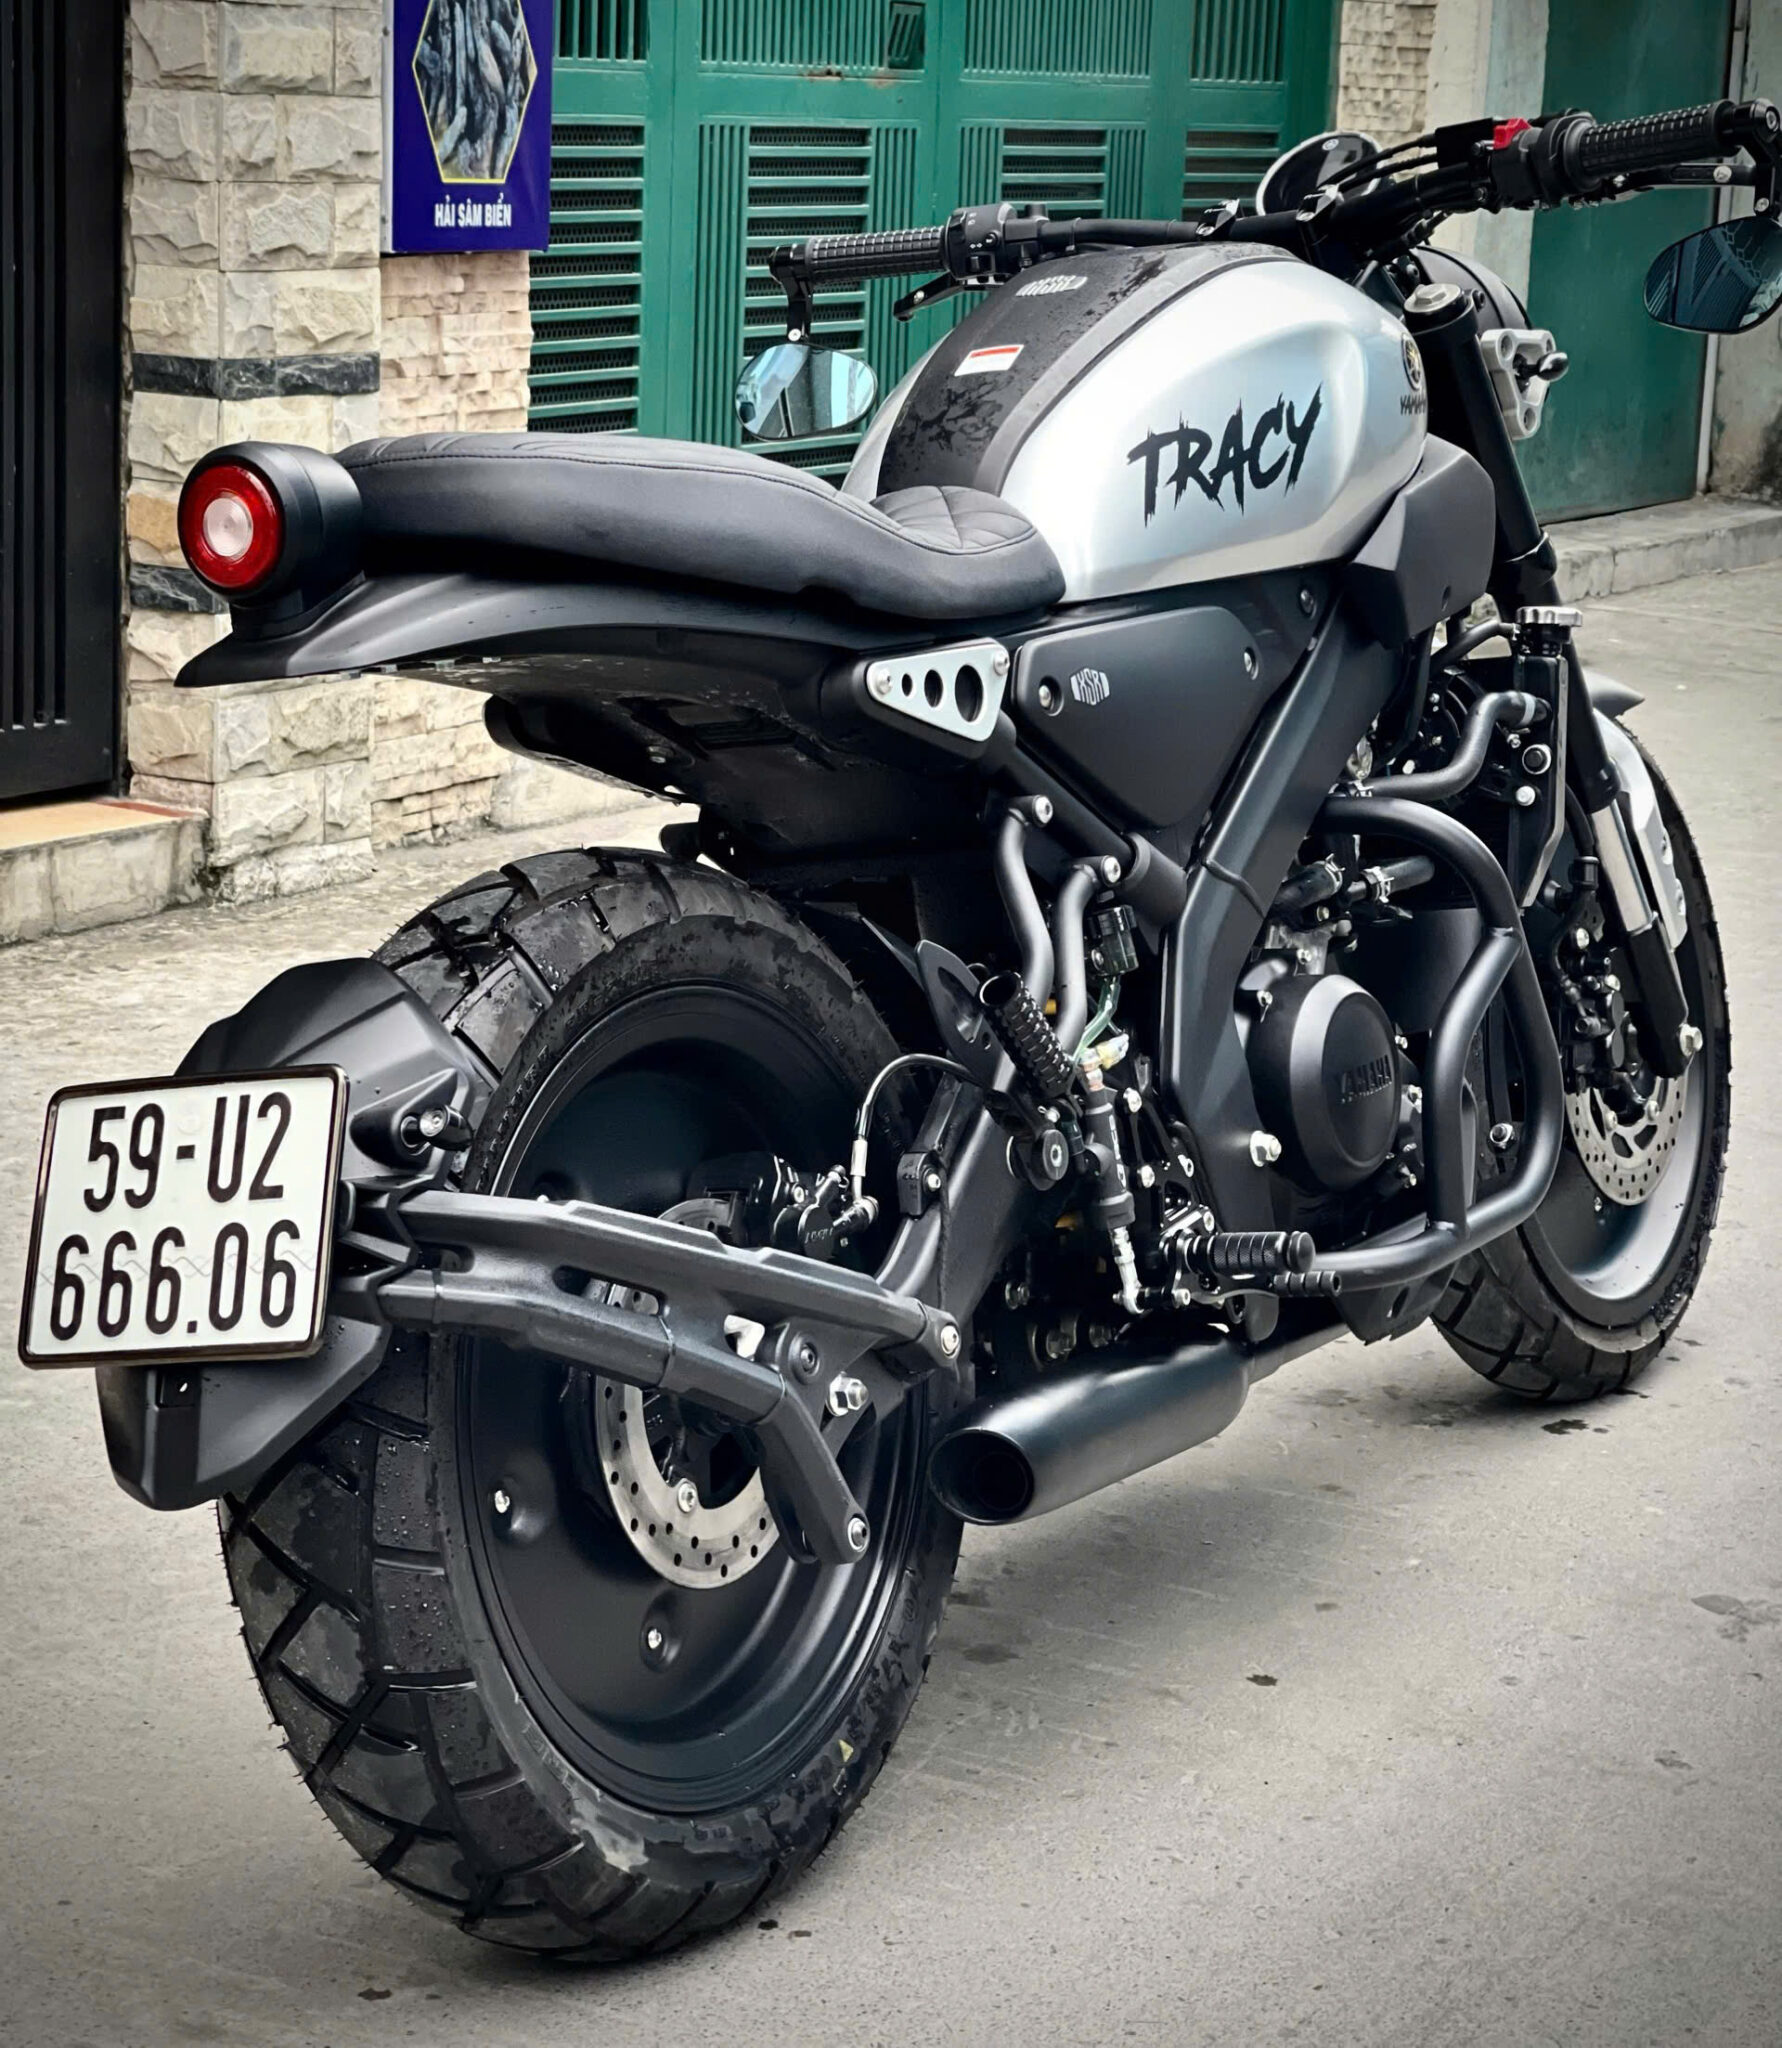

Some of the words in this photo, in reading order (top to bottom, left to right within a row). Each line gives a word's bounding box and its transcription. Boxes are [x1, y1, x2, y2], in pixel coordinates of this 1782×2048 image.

[434, 194, 456, 227] HẢI
[484, 192, 512, 227] BIỂN
[1126, 380, 1323, 528] TRACY
[1075, 667, 1104, 706] XSR
[83, 1091, 292, 1213] 59-U2
[50, 1218, 300, 1341] 666.06
